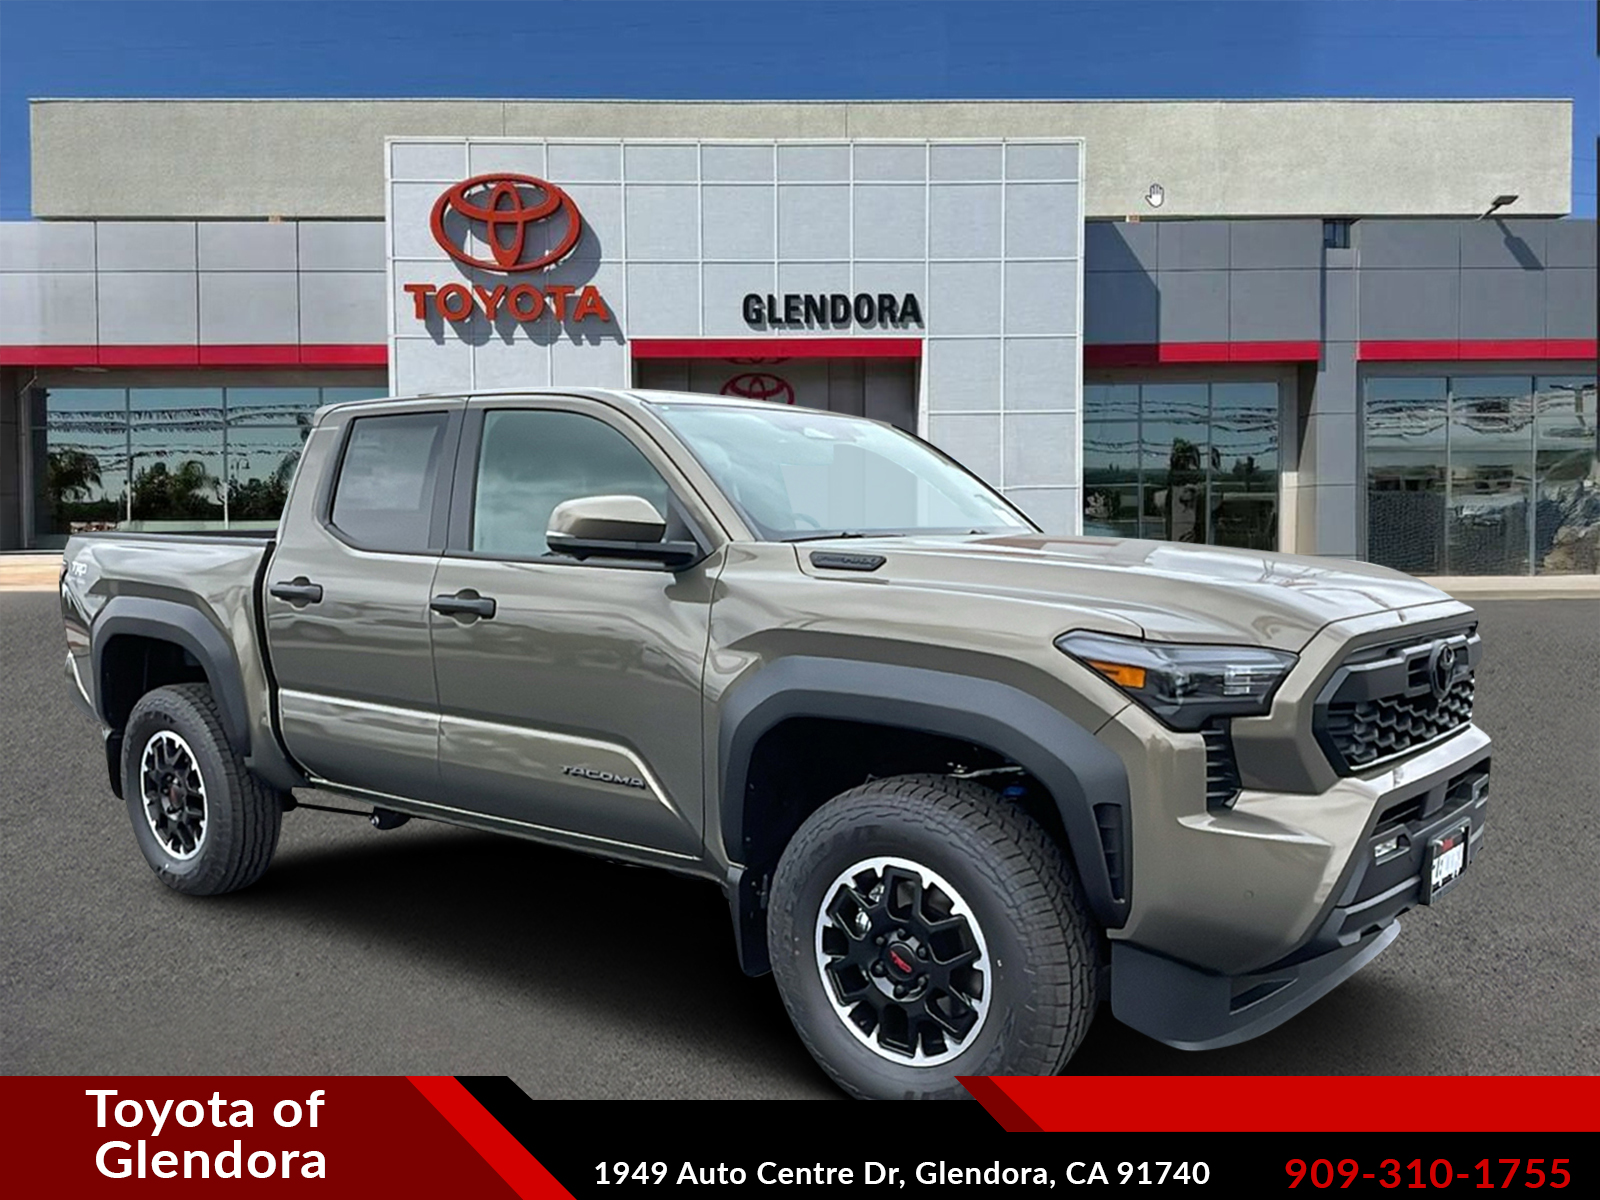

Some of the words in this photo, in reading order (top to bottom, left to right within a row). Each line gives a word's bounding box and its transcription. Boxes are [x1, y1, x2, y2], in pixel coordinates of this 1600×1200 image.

[404, 283, 611, 324] TOYOTA
[742, 292, 923, 326] GLENDORA
[561, 765, 646, 789] TACOMA
